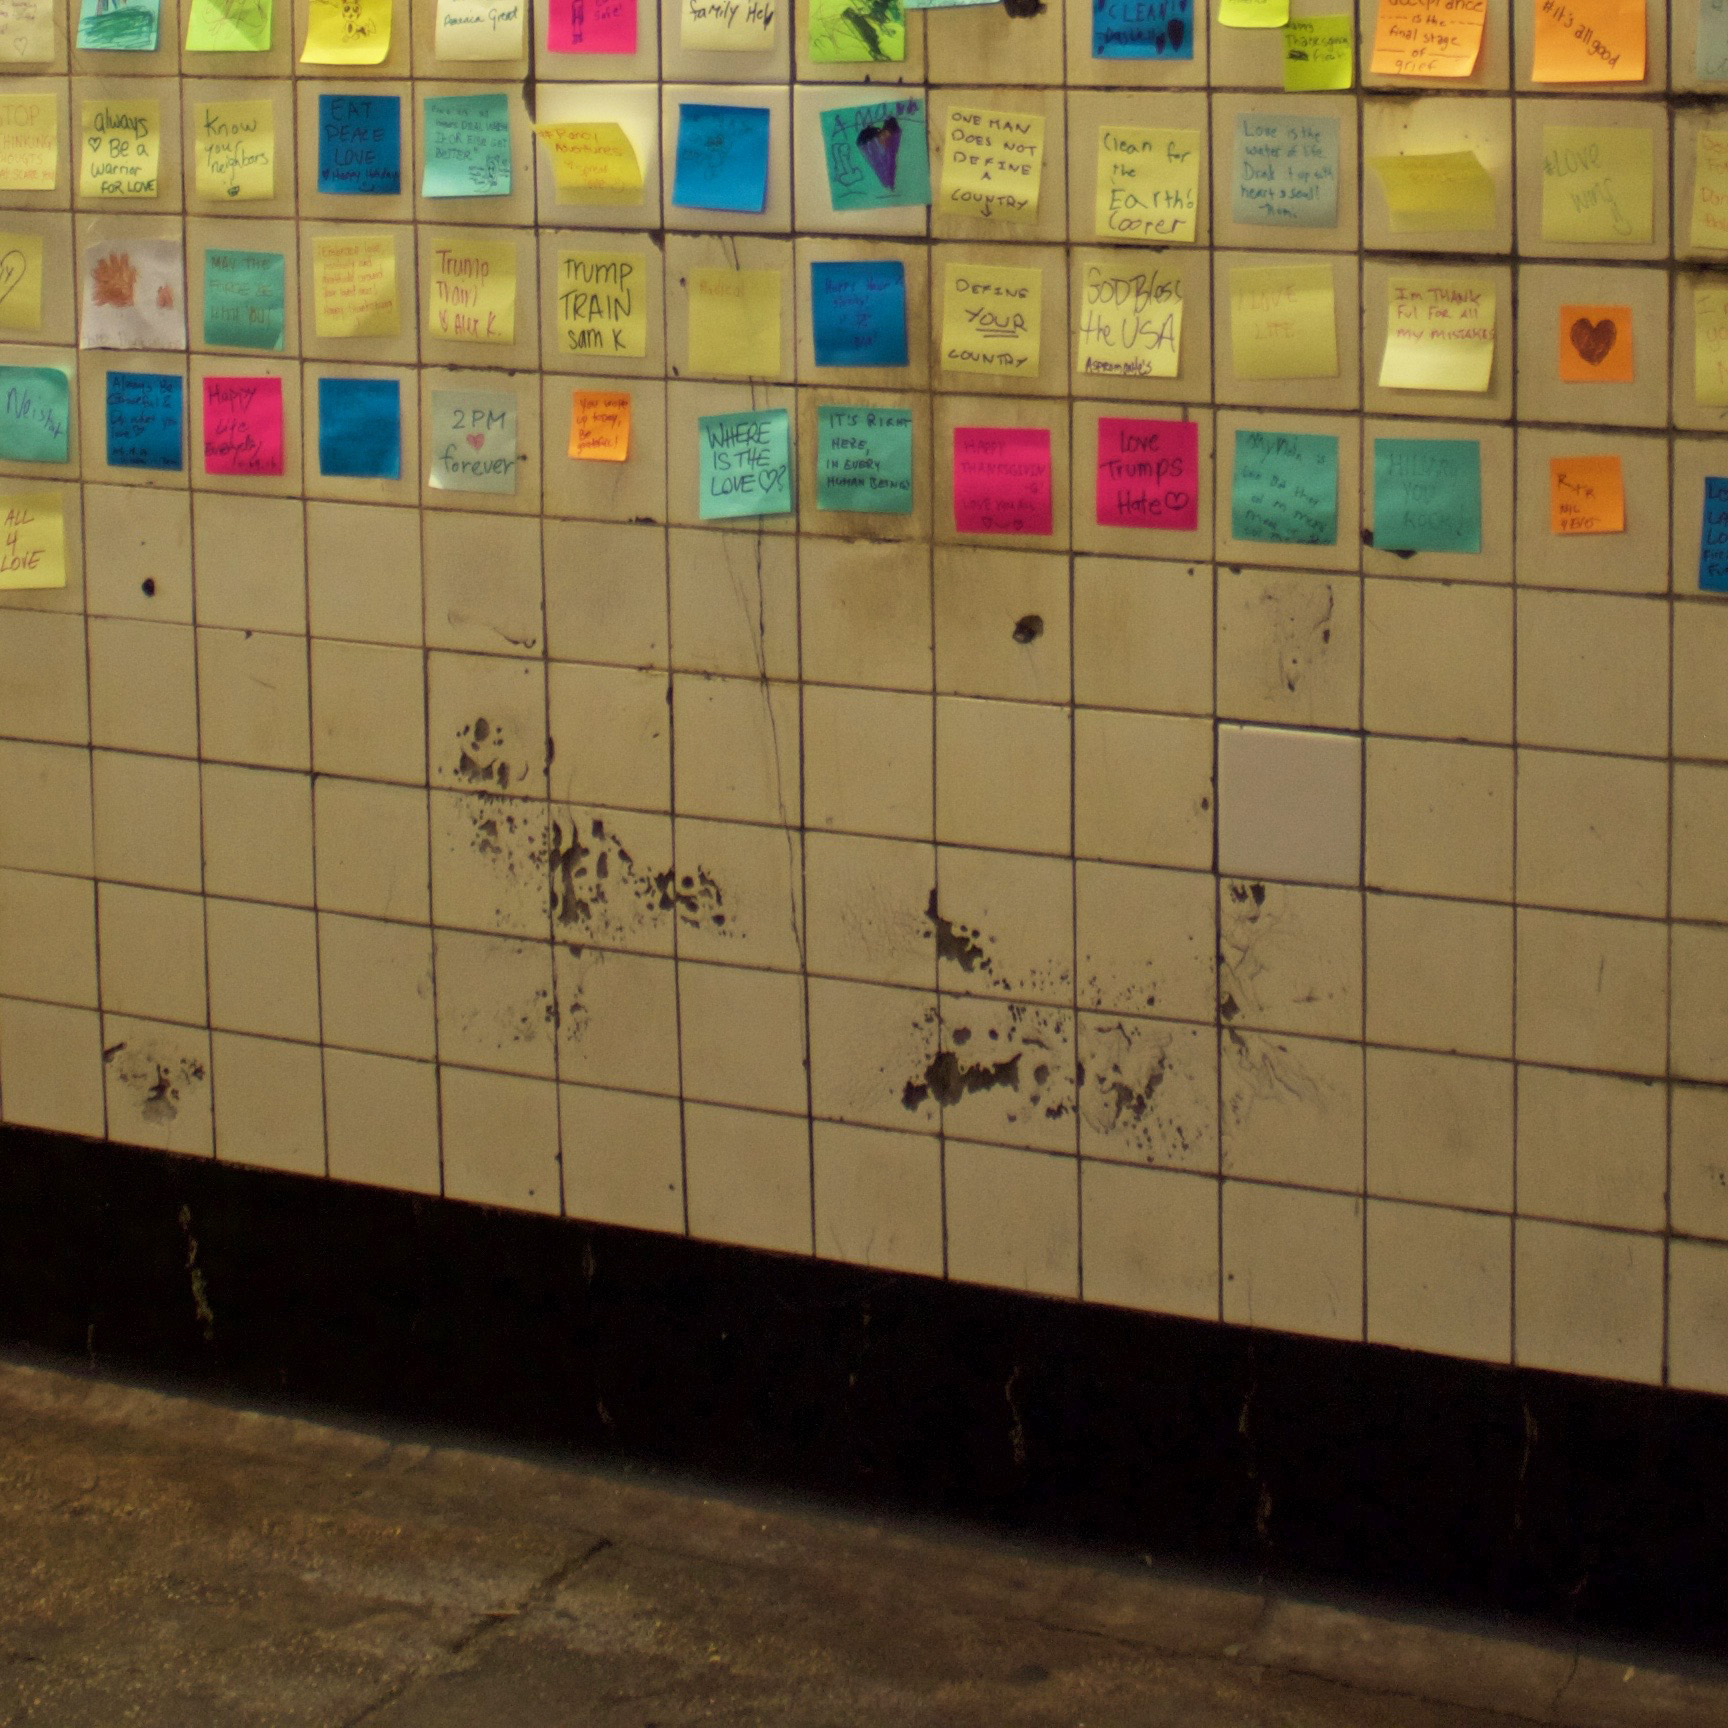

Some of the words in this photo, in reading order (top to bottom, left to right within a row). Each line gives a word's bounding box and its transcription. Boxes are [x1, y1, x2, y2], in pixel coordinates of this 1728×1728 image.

[951, 112, 982, 126] ONE
[988, 118, 1032, 134] MAN
[951, 128, 991, 148] DOES
[1003, 141, 1037, 156] NOT
[955, 278, 1029, 299] DEFINE
[559, 291, 633, 320] TRAIN
[707, 422, 771, 448] WHERE
[712, 450, 732, 469] IS
[738, 447, 771, 468] THE
[711, 473, 756, 496] LOVE
